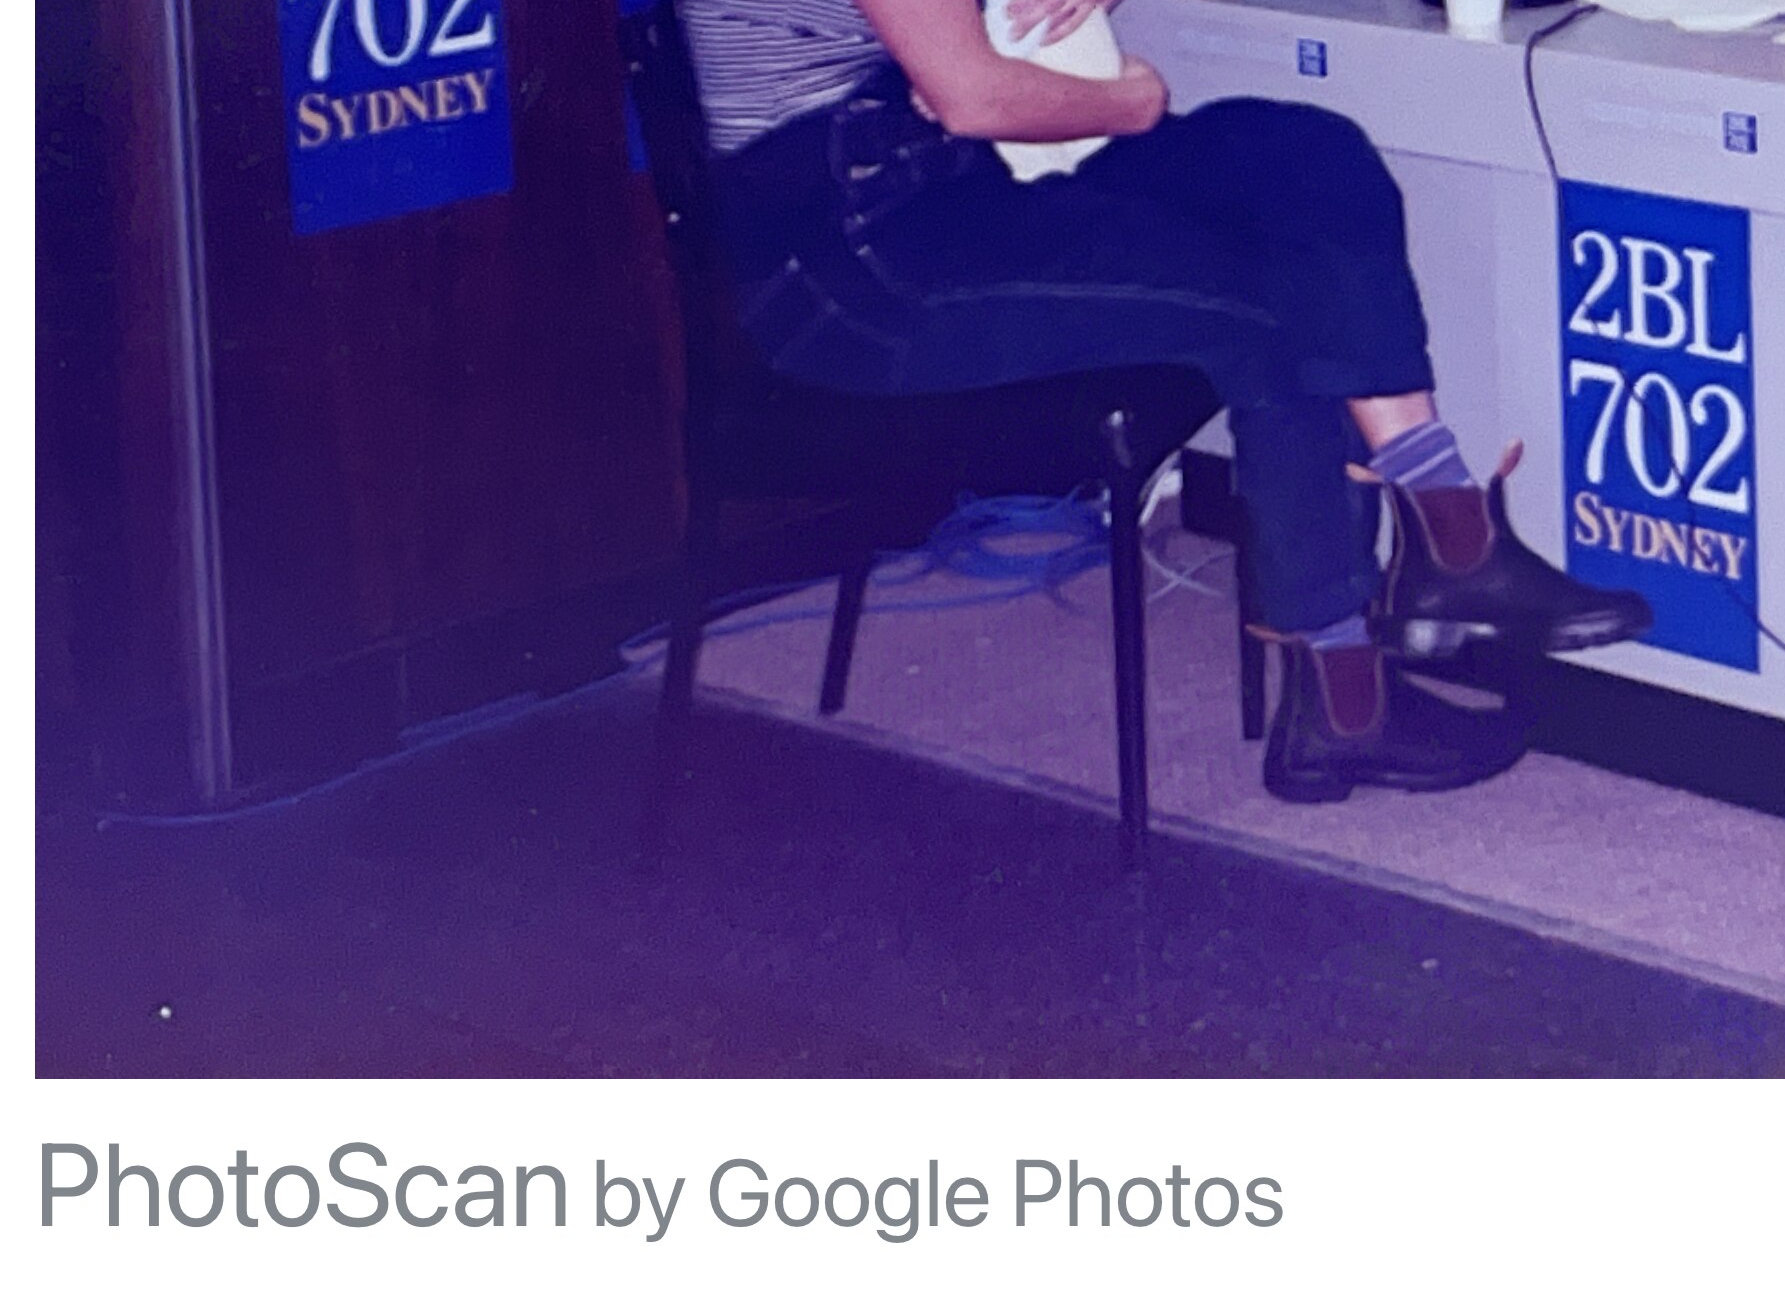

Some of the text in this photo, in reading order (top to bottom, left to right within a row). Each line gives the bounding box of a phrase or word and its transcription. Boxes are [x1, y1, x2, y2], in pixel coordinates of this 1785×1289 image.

[297, 67, 495, 149] SYDNEY
[1568, 229, 1747, 364] 2BL
[1569, 358, 1749, 514] 702
[1573, 489, 1748, 581] SYDNEY
